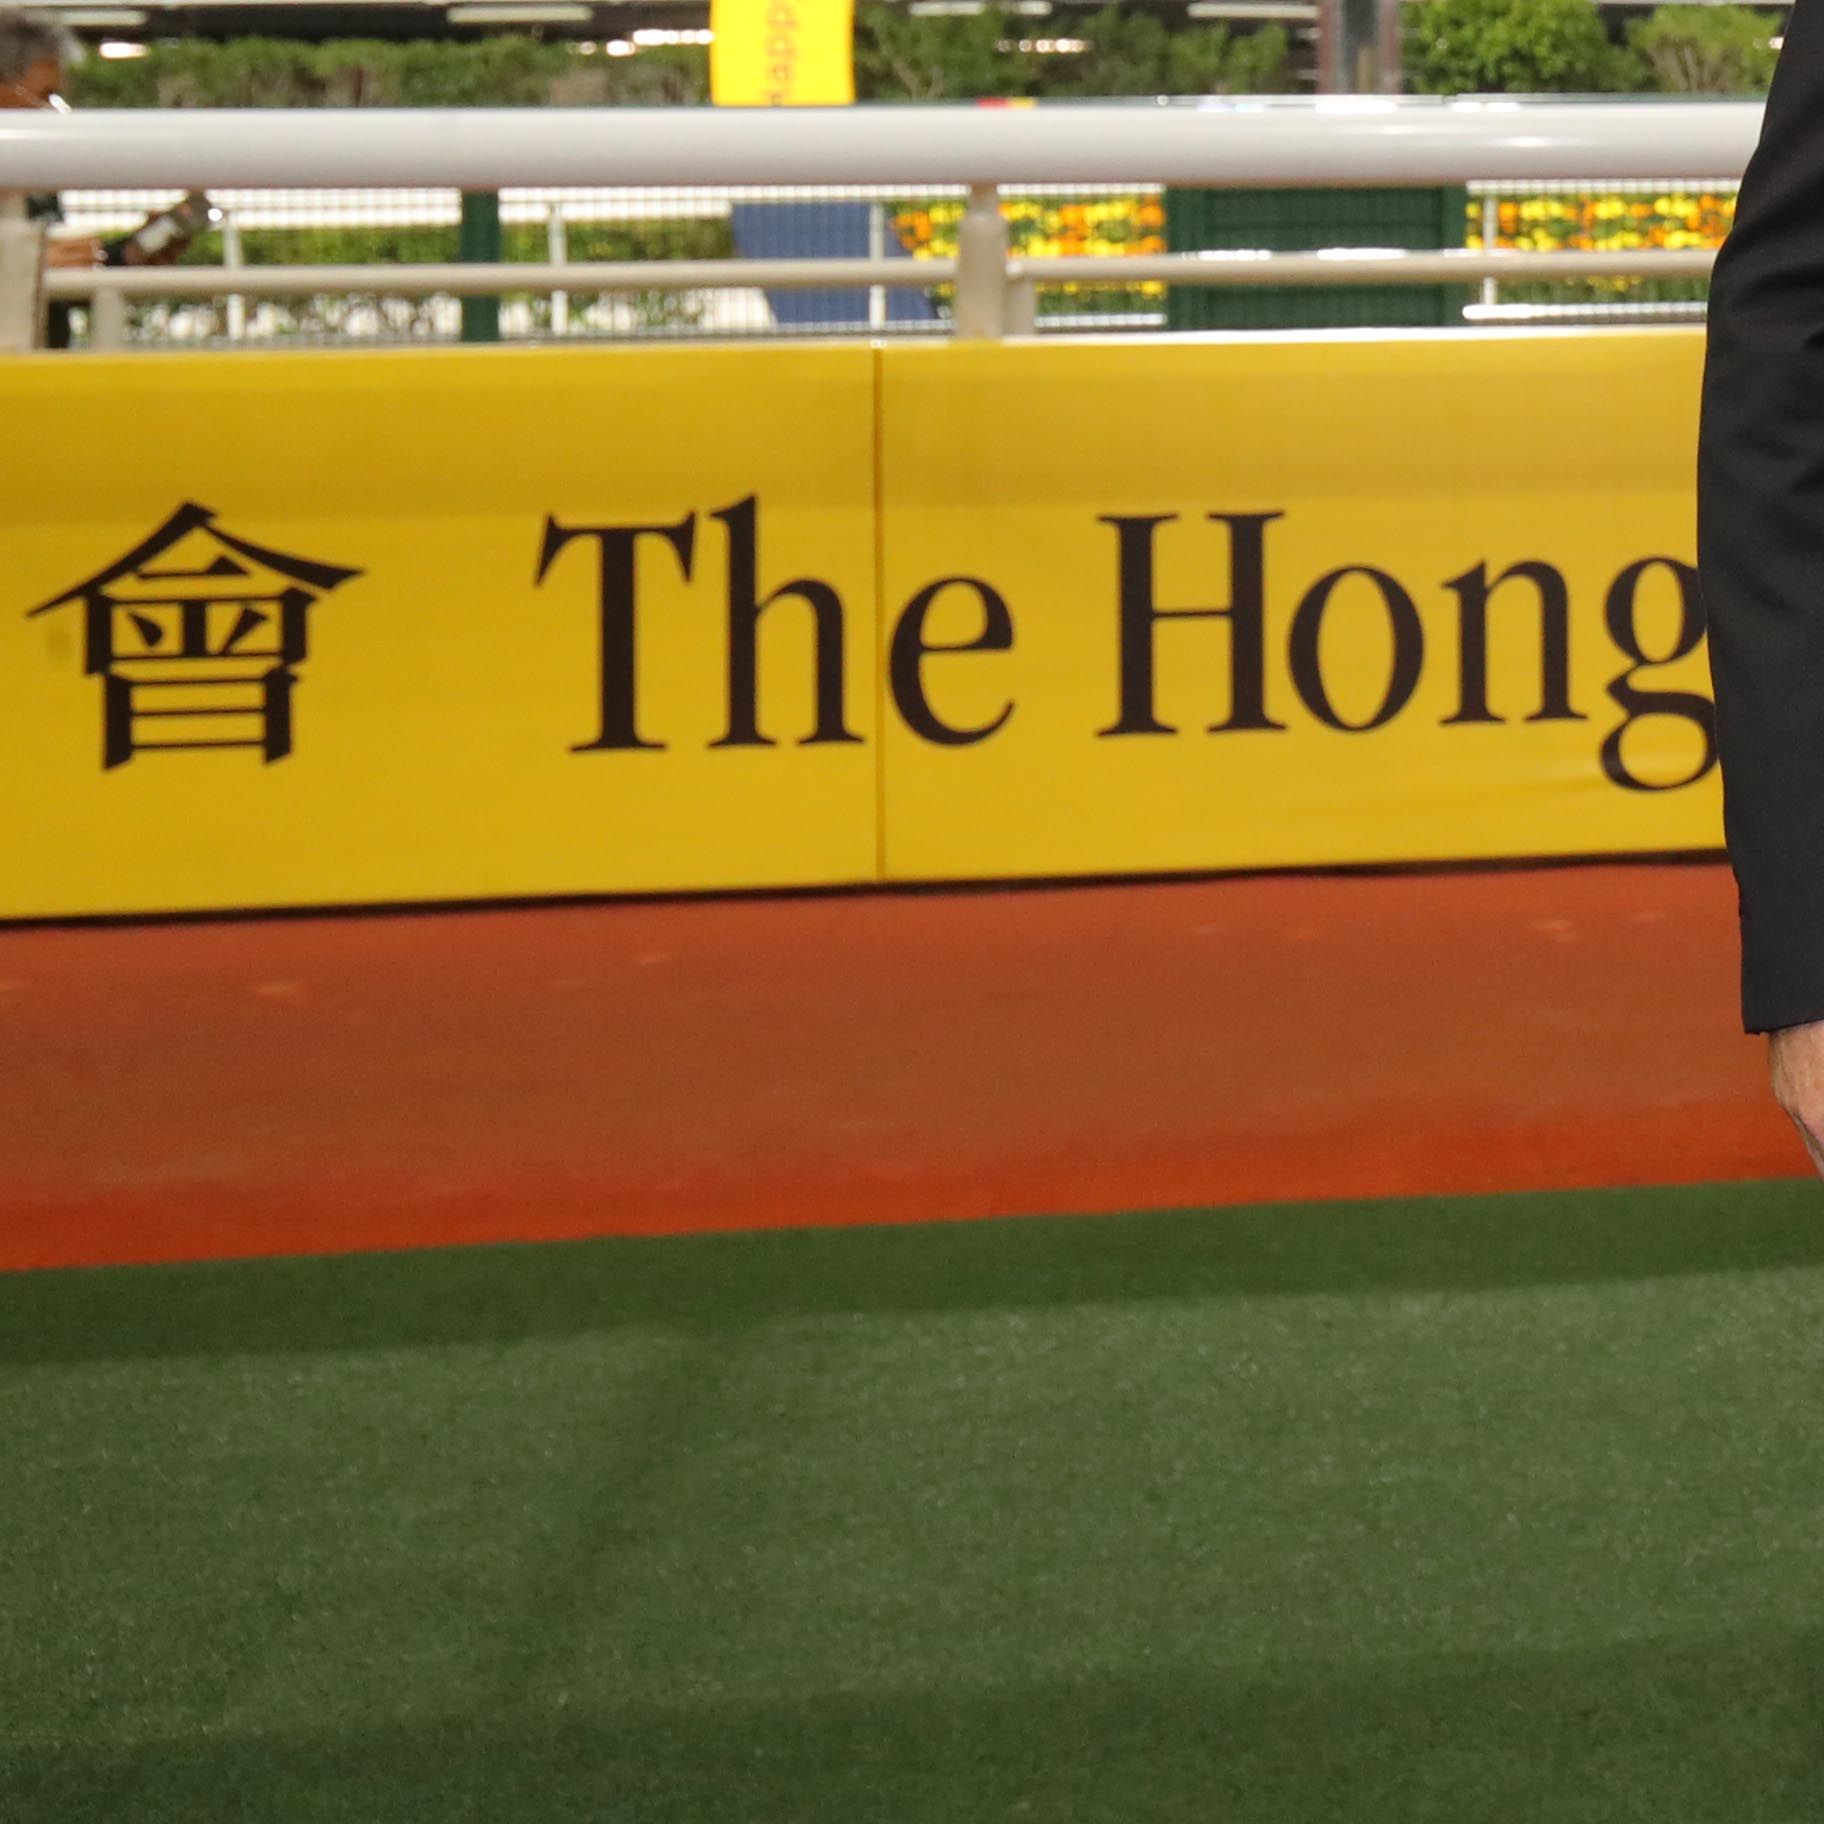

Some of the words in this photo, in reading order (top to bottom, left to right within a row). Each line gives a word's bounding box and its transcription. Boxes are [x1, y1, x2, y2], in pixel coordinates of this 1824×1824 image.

[28, 498, 365, 772] 會
[534, 494, 1017, 754] The
[1092, 508, 1718, 794] Hong
